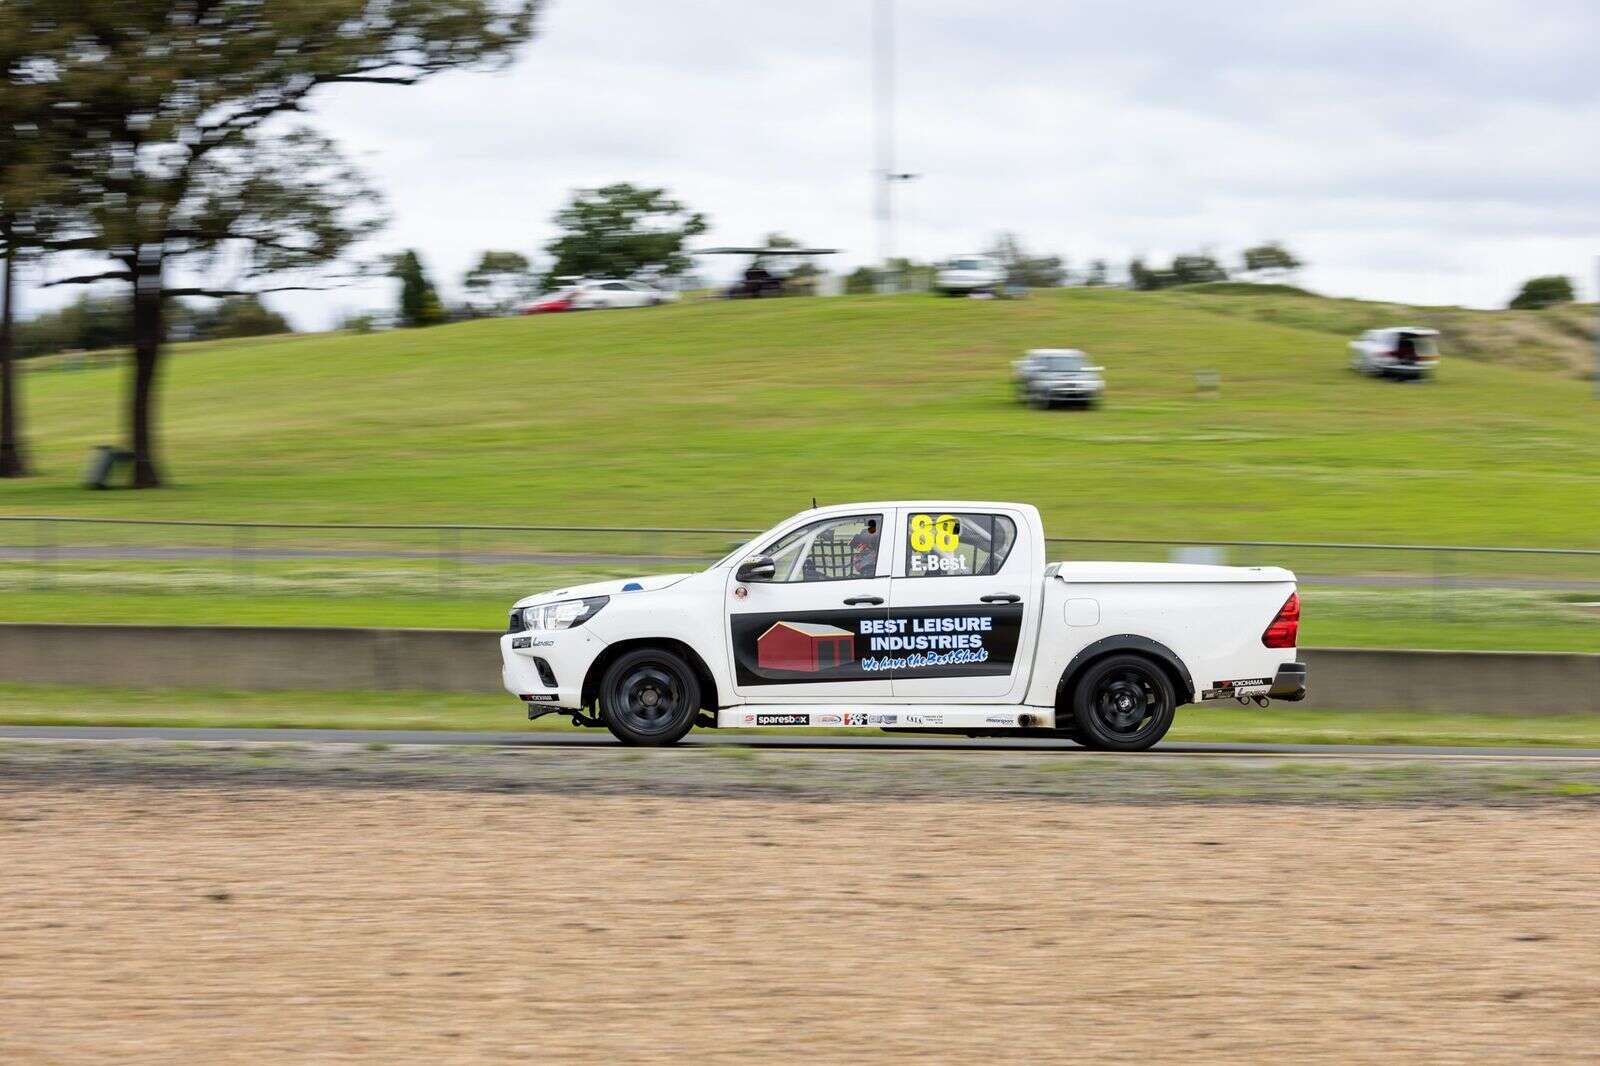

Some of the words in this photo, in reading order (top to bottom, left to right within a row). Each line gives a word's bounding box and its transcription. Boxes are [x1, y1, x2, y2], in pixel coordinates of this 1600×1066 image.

[911, 514, 959, 552] 88
[911, 554, 967, 571] E.Best
[860, 620, 907, 634] BEST
[913, 617, 992, 632] LEISURE
[870, 635, 982, 651] INDUSTRIES
[861, 656, 879, 671] We
[880, 656, 906, 671] have
[907, 653, 927, 668] the
[1232, 679, 1264, 687] YOKOHAMA
[758, 714, 808, 725] sparesbox
